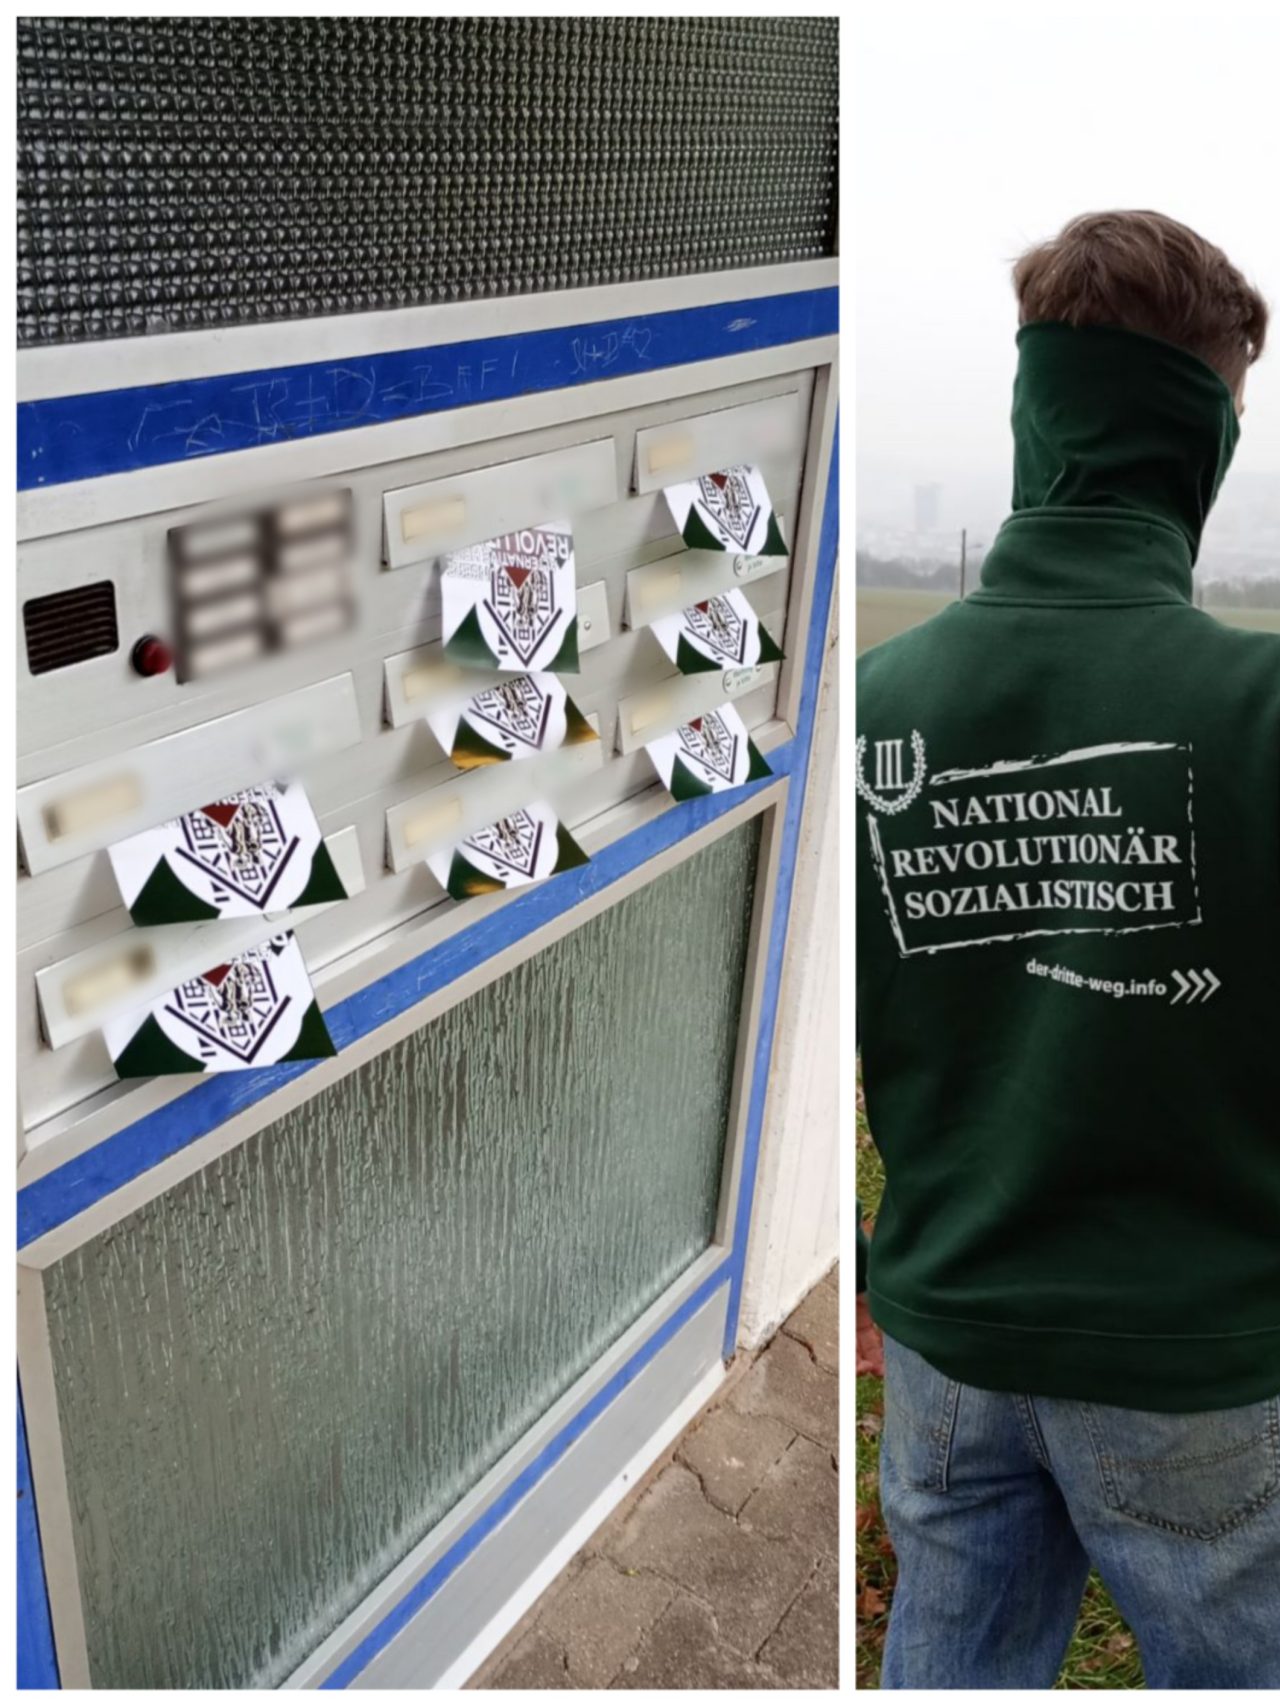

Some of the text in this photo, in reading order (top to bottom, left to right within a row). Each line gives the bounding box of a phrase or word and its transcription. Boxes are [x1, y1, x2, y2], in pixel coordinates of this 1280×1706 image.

[930, 787, 1122, 829] NATIONAL
[891, 826, 1182, 877] REVOLUTIONÄR
[904, 879, 1175, 919] SOZIALISTISCH
[1026, 958, 1167, 998] der-dritte-weg.info
